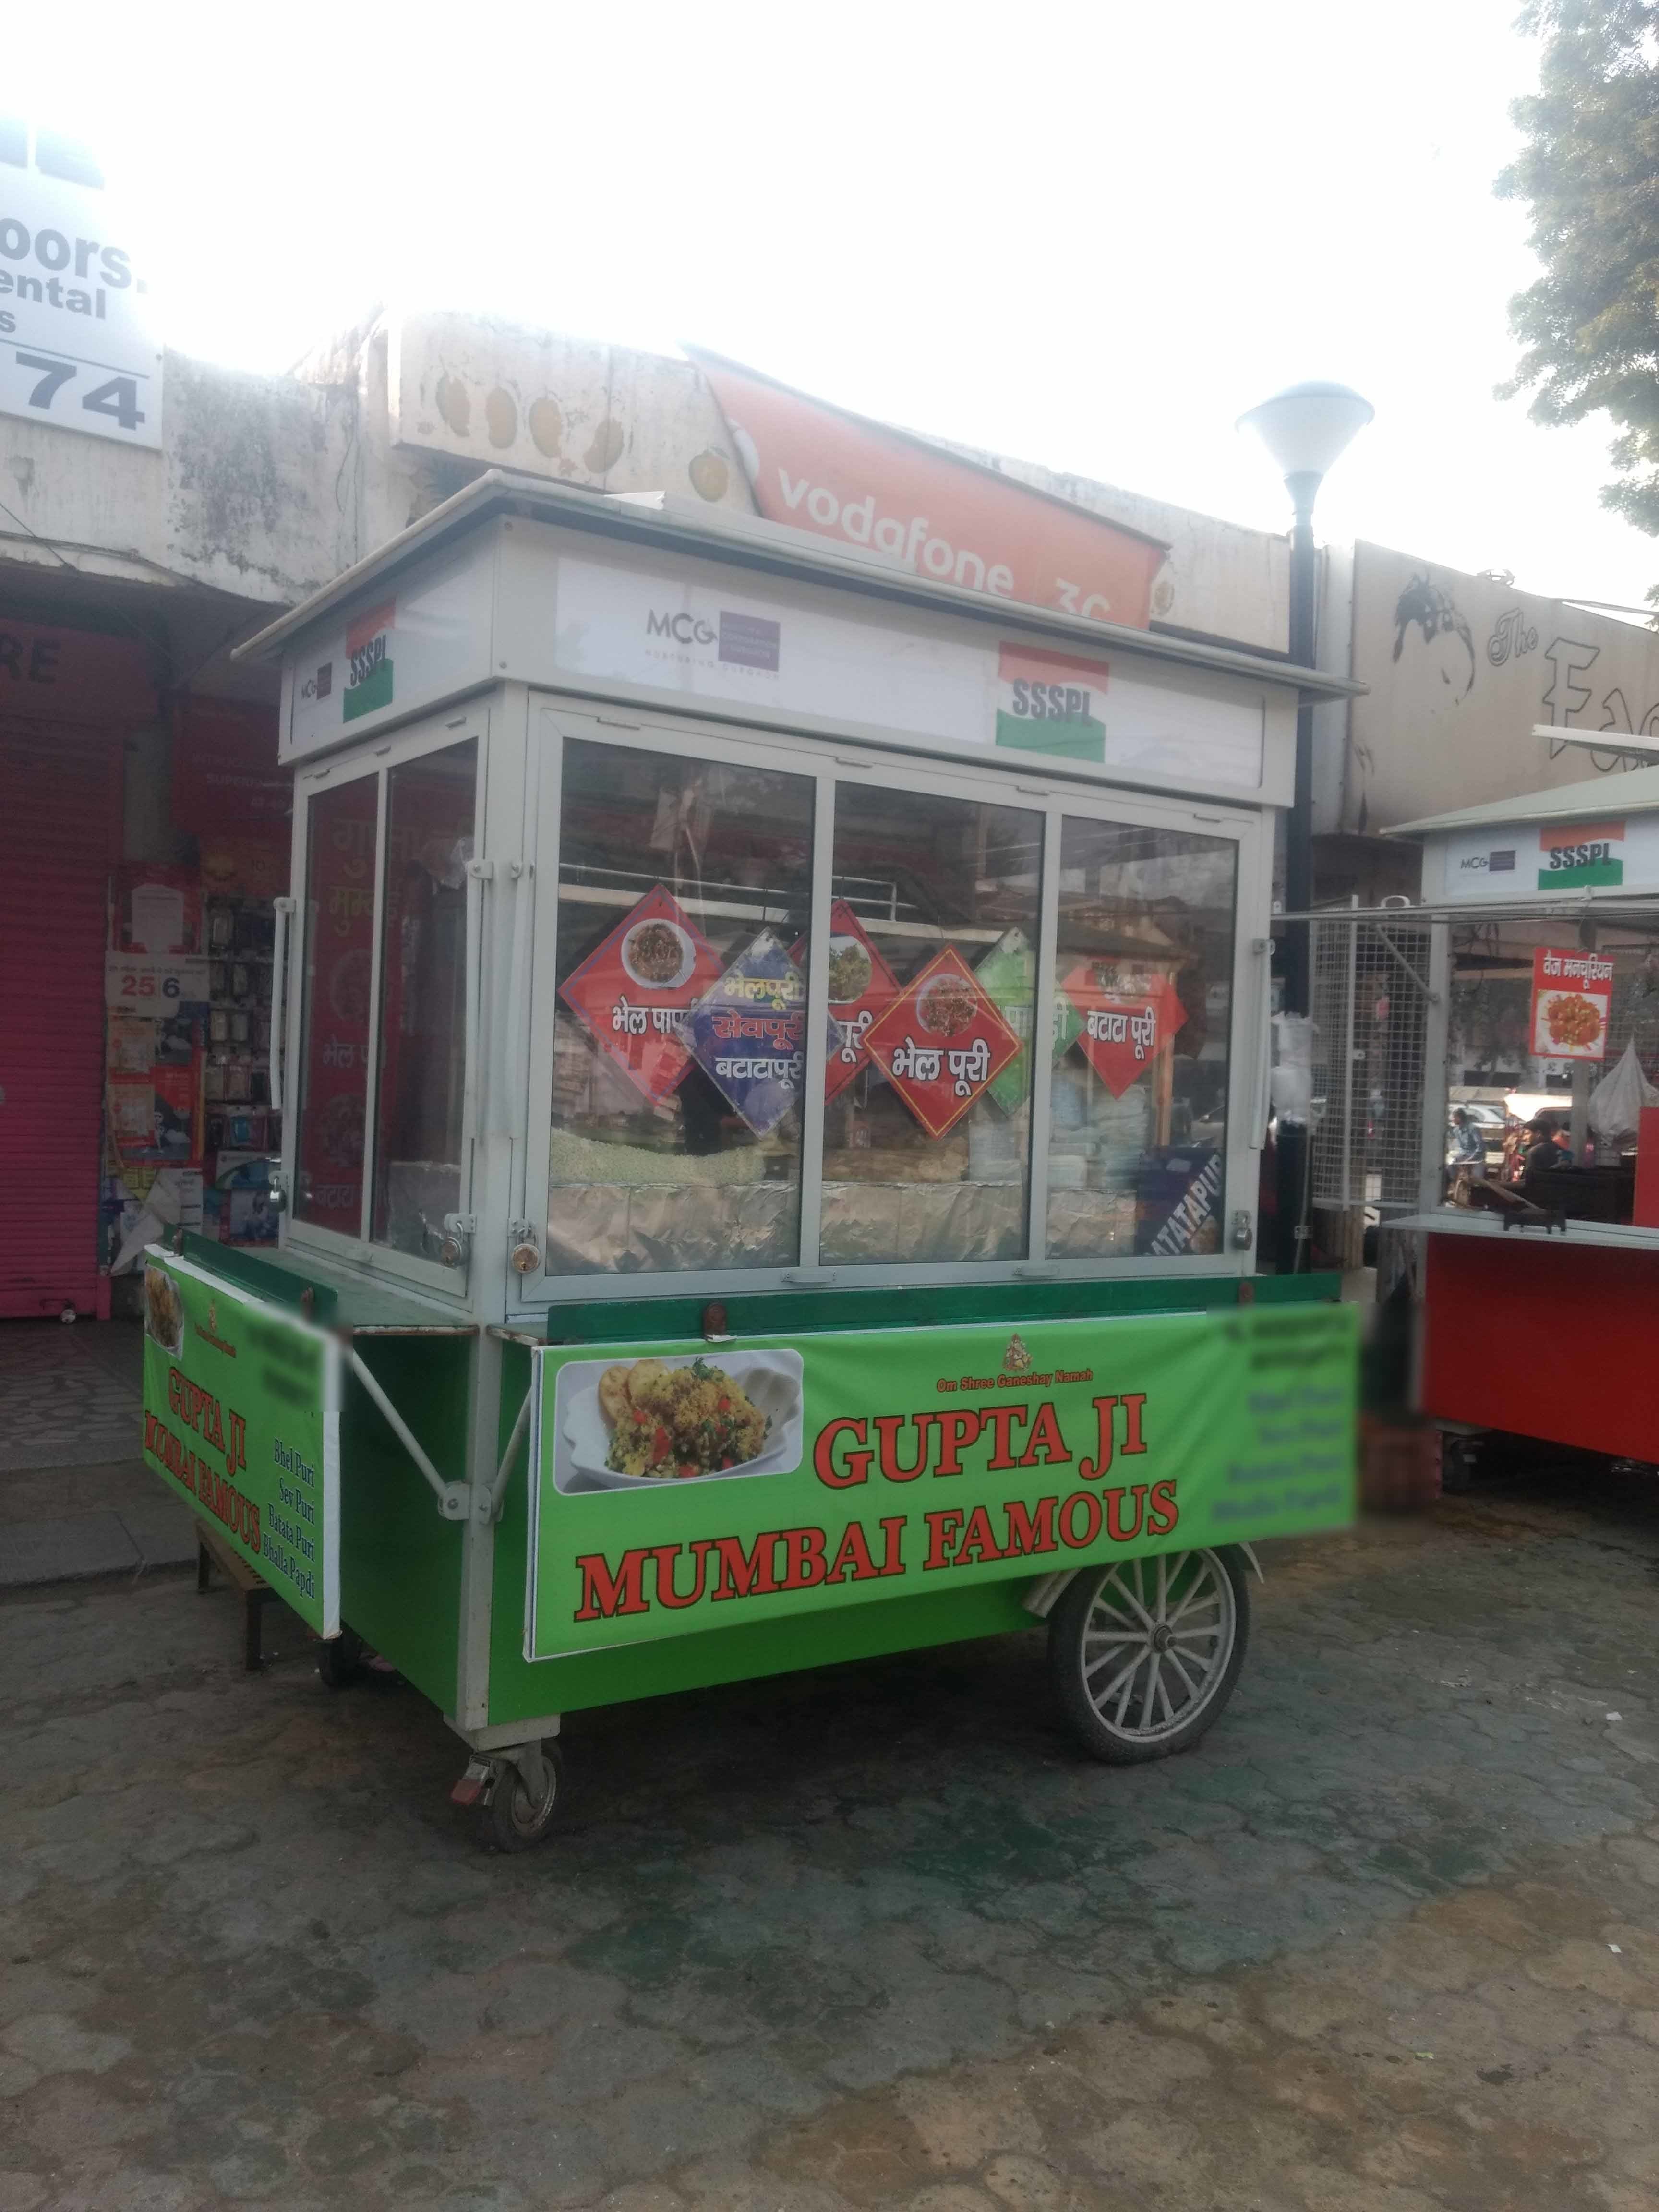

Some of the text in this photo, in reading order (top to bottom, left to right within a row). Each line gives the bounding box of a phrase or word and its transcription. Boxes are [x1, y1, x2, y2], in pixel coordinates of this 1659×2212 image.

[15, 351, 145, 431] 74
[777, 467, 1014, 597] vodafone
[646, 608, 718, 644] MCG
[1487, 607, 1539, 667] The
[350, 634, 386, 687] SSSPL
[1011, 677, 1094, 726] SSSPL
[1461, 857, 1489, 869] MCG
[1550, 843, 1611, 869] SSSPL
[122, 975, 155, 996] 25
[612, 993, 649, 1034] भेल
[1087, 1006, 1156, 1059] बटाटा पूरी
[892, 1036, 990, 1096] भेल पूरी
[937, 1368, 1093, 1393] Om Shree Ganeshay Namah
[168, 1366, 246, 1477] GUPTA JI
[813, 1393, 1148, 1490] GUPTA JI
[145, 1410, 261, 1554] MUMBAI FAMOUS
[274, 1437, 315, 1488] Bhel Puri
[279, 1477, 315, 1525] Sev Puri
[268, 1503, 315, 1562] Batata Puri
[573, 1479, 1180, 1623] MUMBAI FAMOUS
[264, 1532, 315, 1600] Bhalla Papdi
